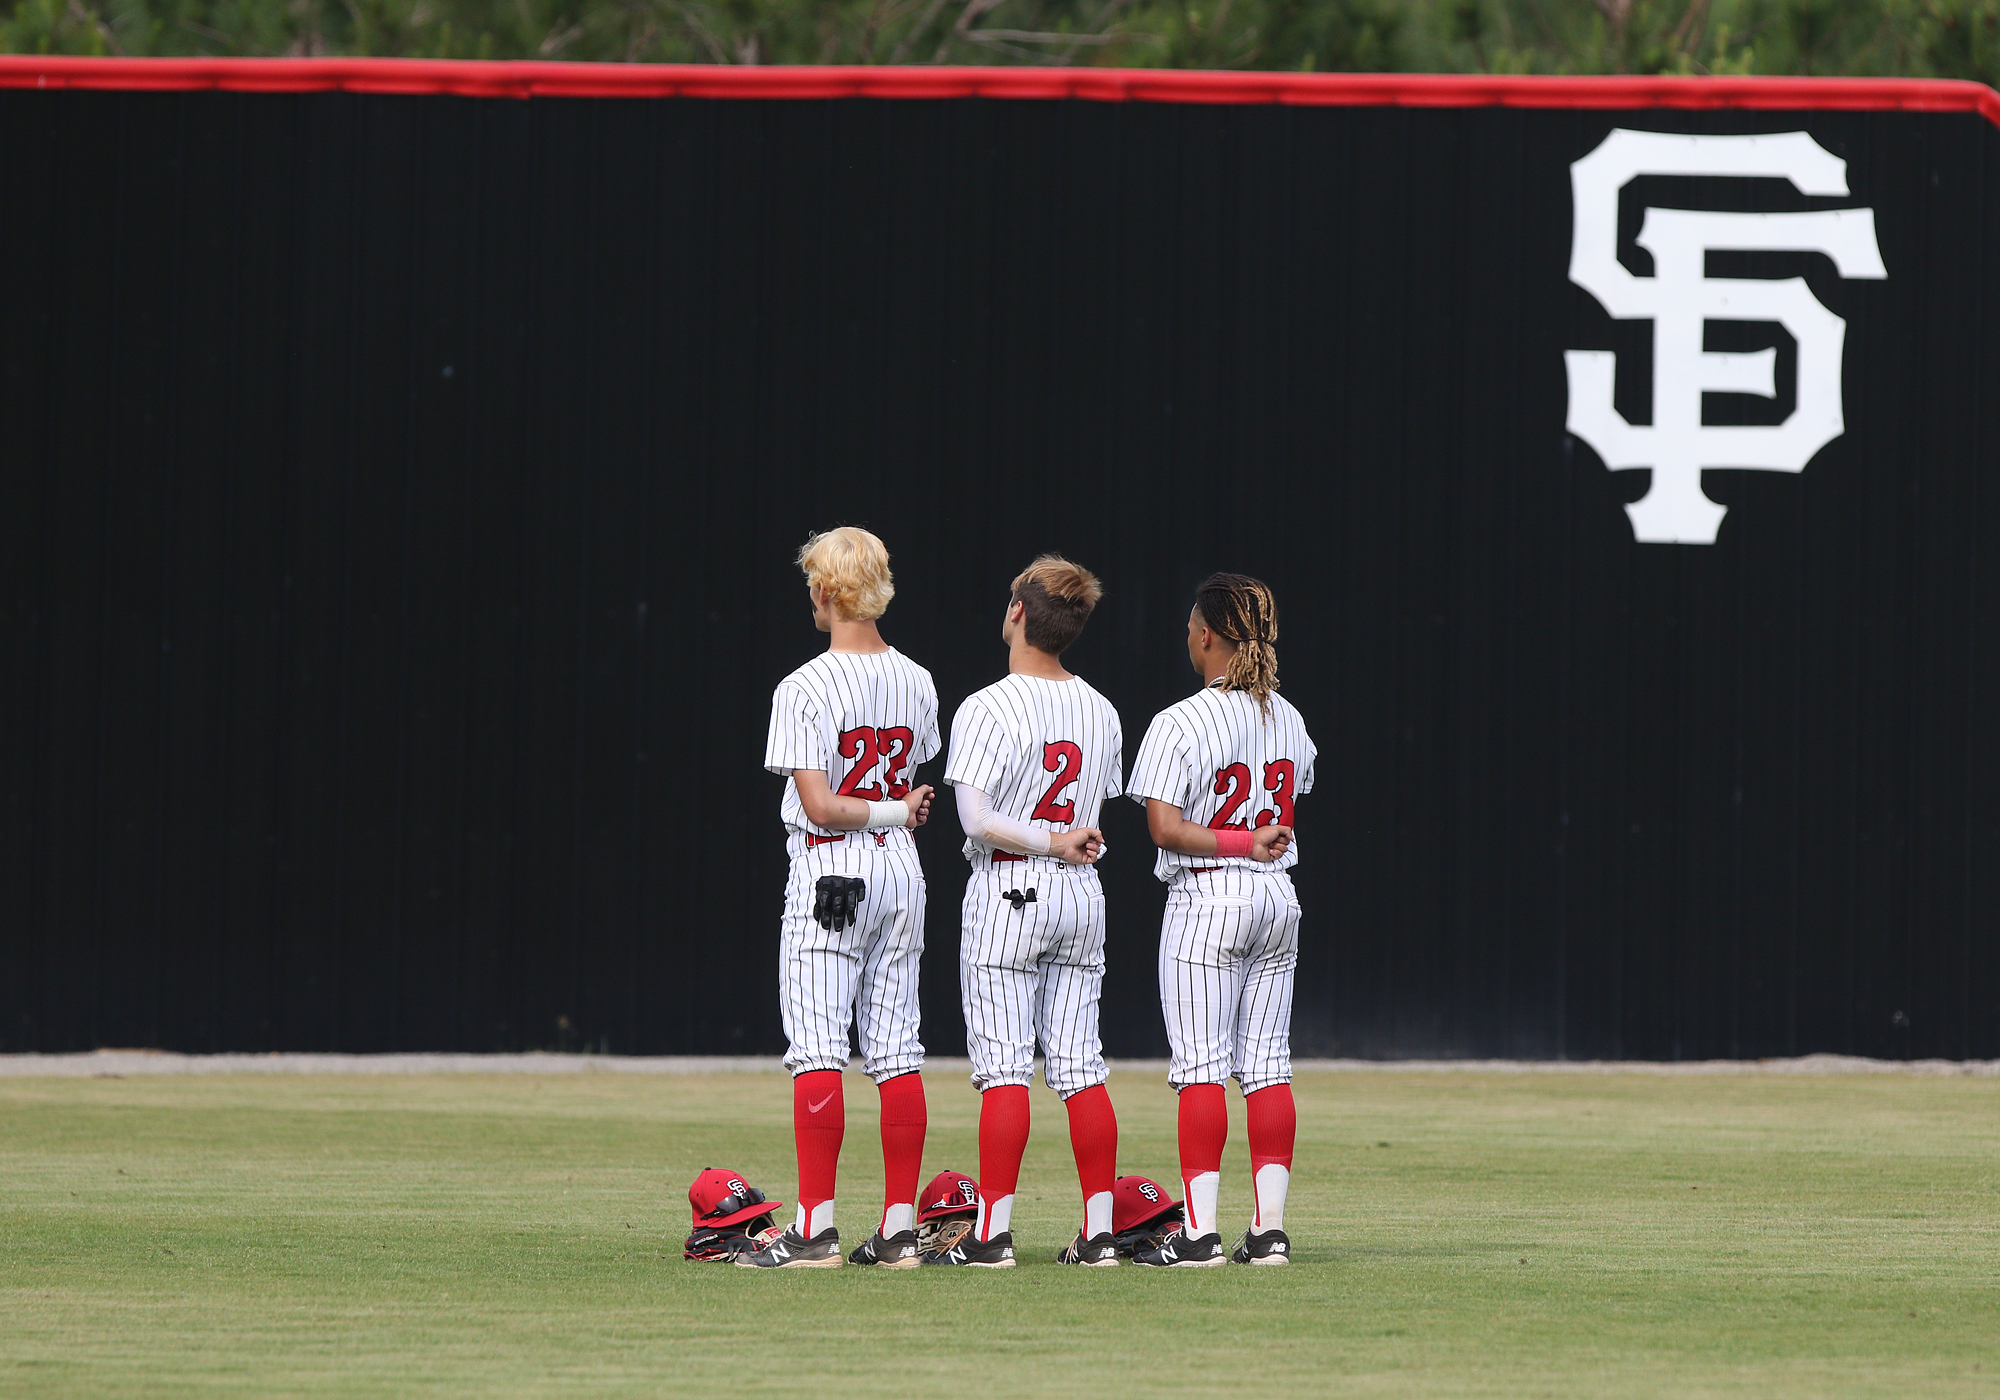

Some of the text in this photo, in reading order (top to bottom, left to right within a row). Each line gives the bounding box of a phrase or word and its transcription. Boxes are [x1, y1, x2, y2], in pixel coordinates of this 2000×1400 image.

[1563, 127, 1889, 545] SF
[837, 725, 914, 801] 22
[1030, 740, 1083, 825] 2
[1207, 758, 1294, 831] 23
[770, 1243, 791, 1263] N
[949, 1245, 968, 1265] N
[1098, 1247, 1115, 1259] NB
[1160, 1245, 1179, 1264] N
[1268, 1242, 1286, 1253] NB
